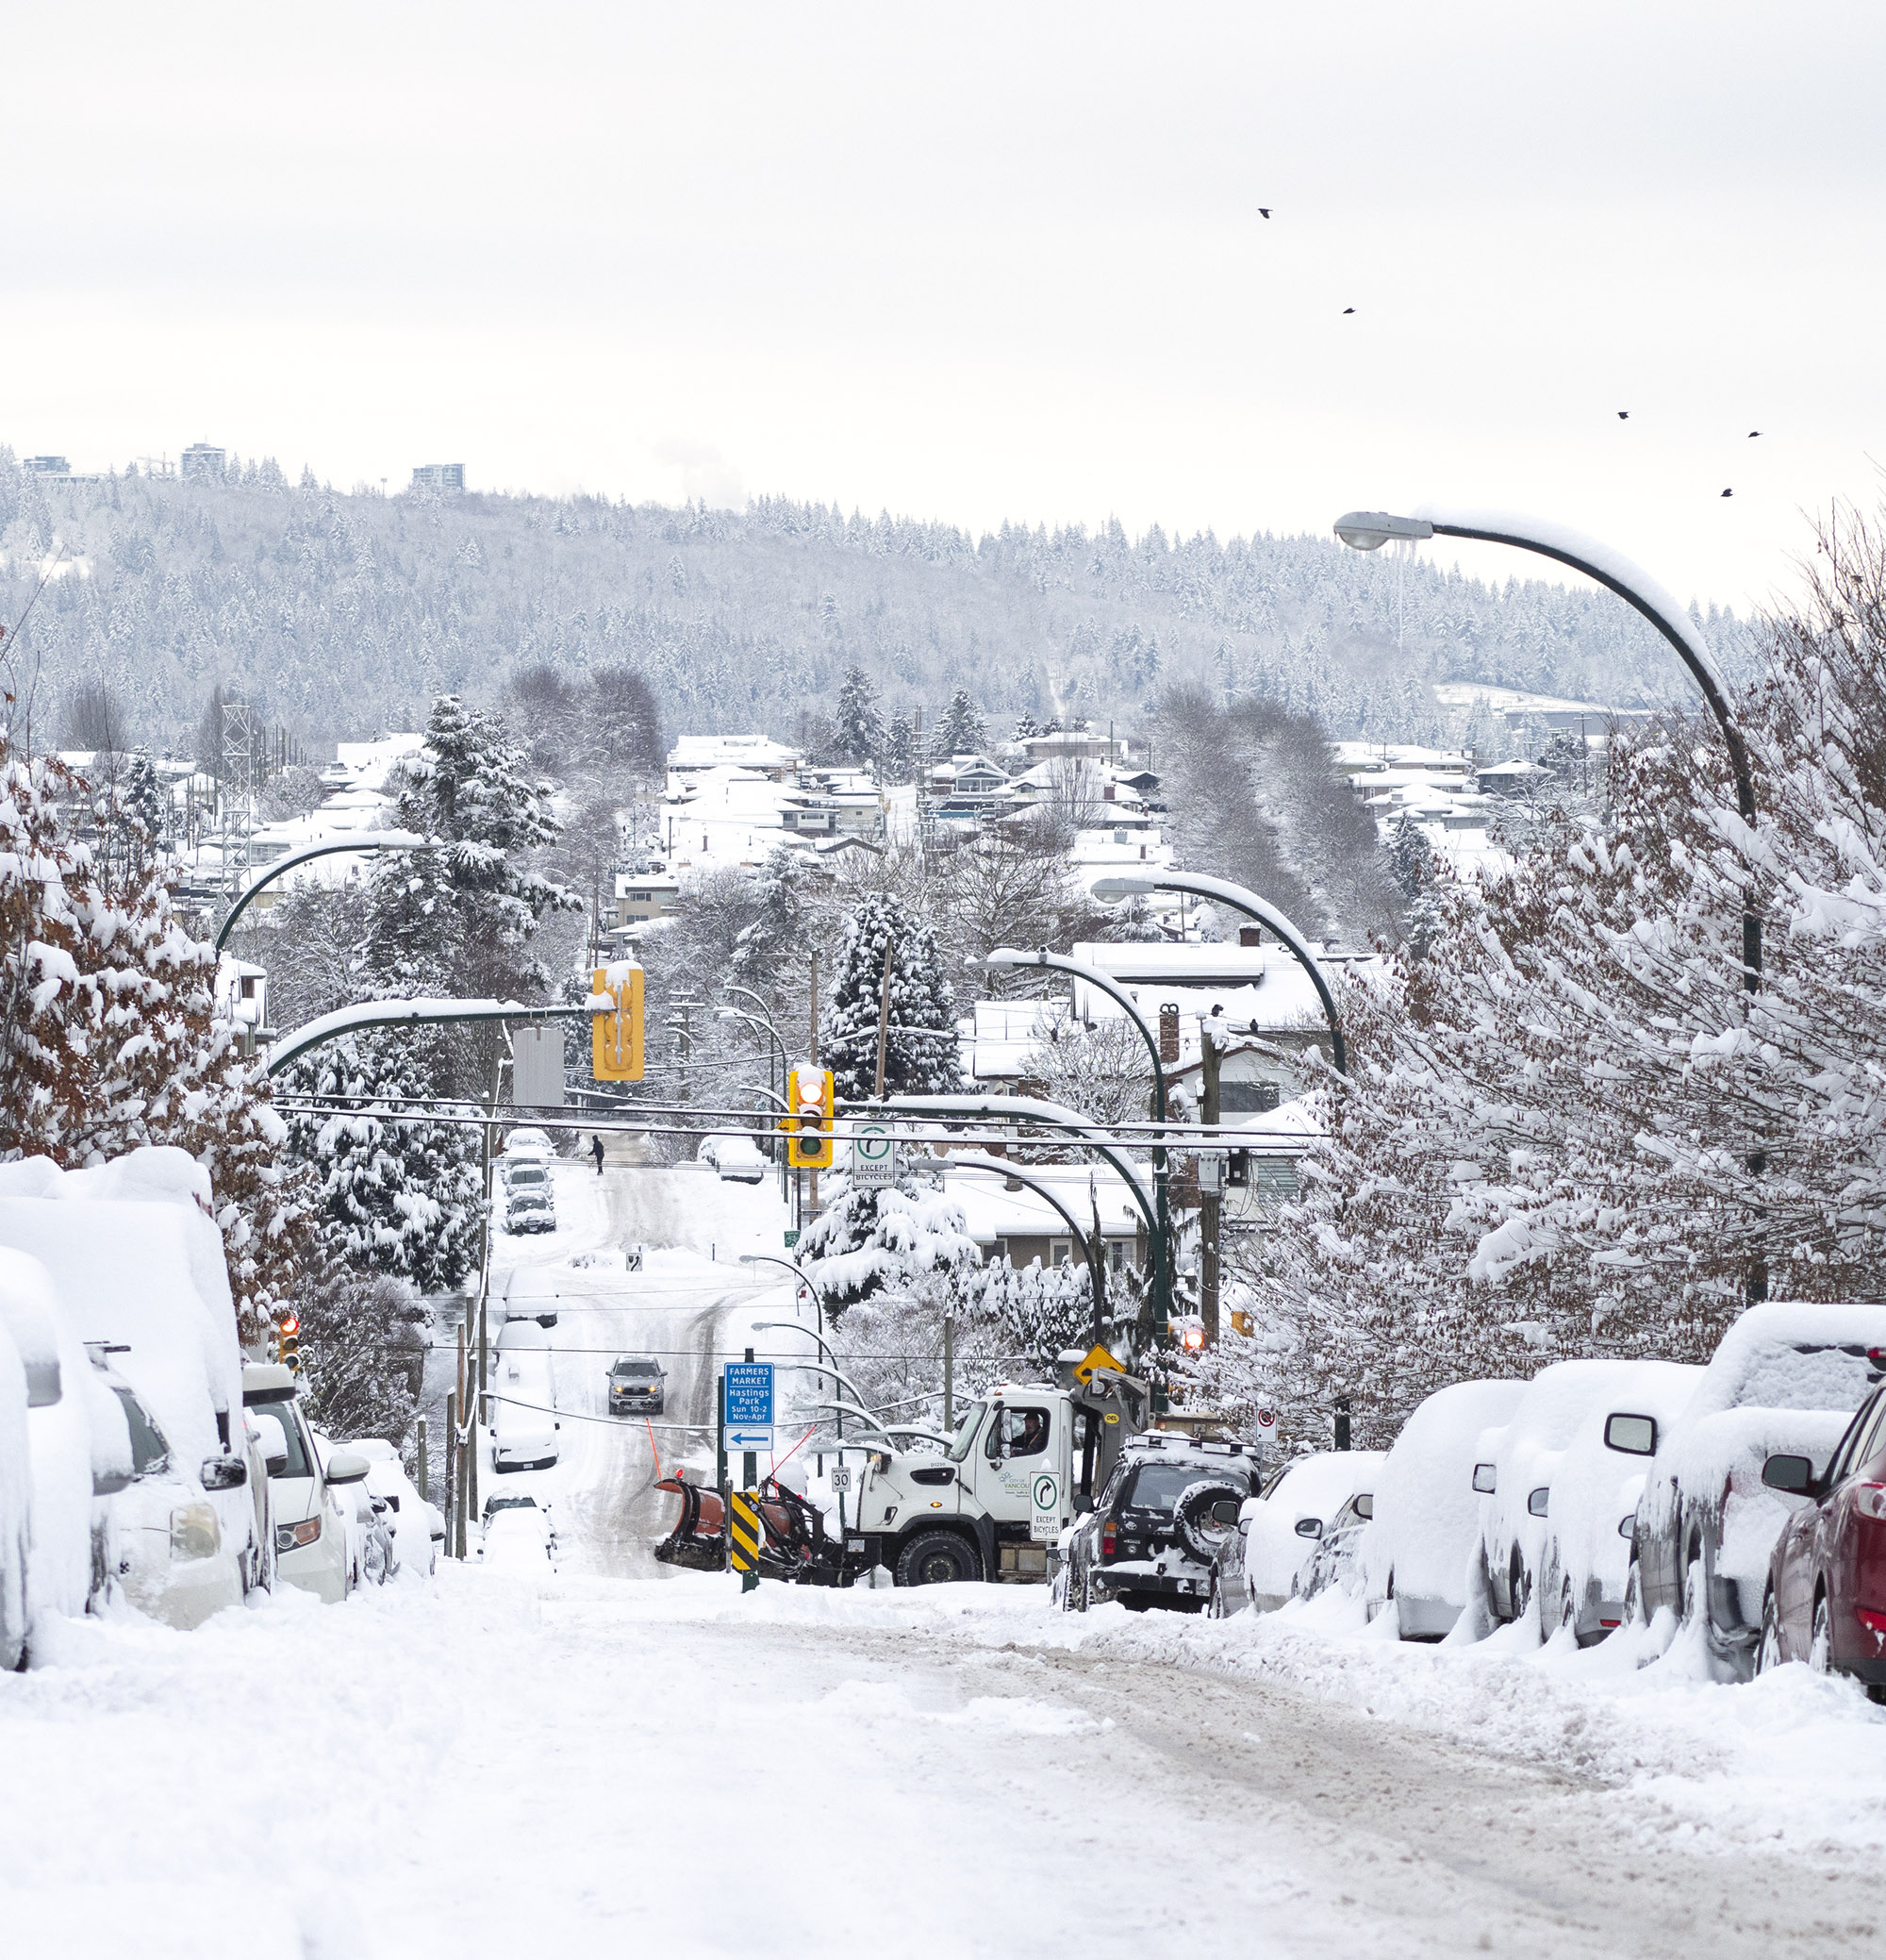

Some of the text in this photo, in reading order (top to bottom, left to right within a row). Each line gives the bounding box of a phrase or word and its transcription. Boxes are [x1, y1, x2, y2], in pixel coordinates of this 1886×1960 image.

[729, 1388, 769, 1398] Hastings
[835, 1474, 849, 1486] 30
[1034, 1525, 1059, 1534] BICYCLES
